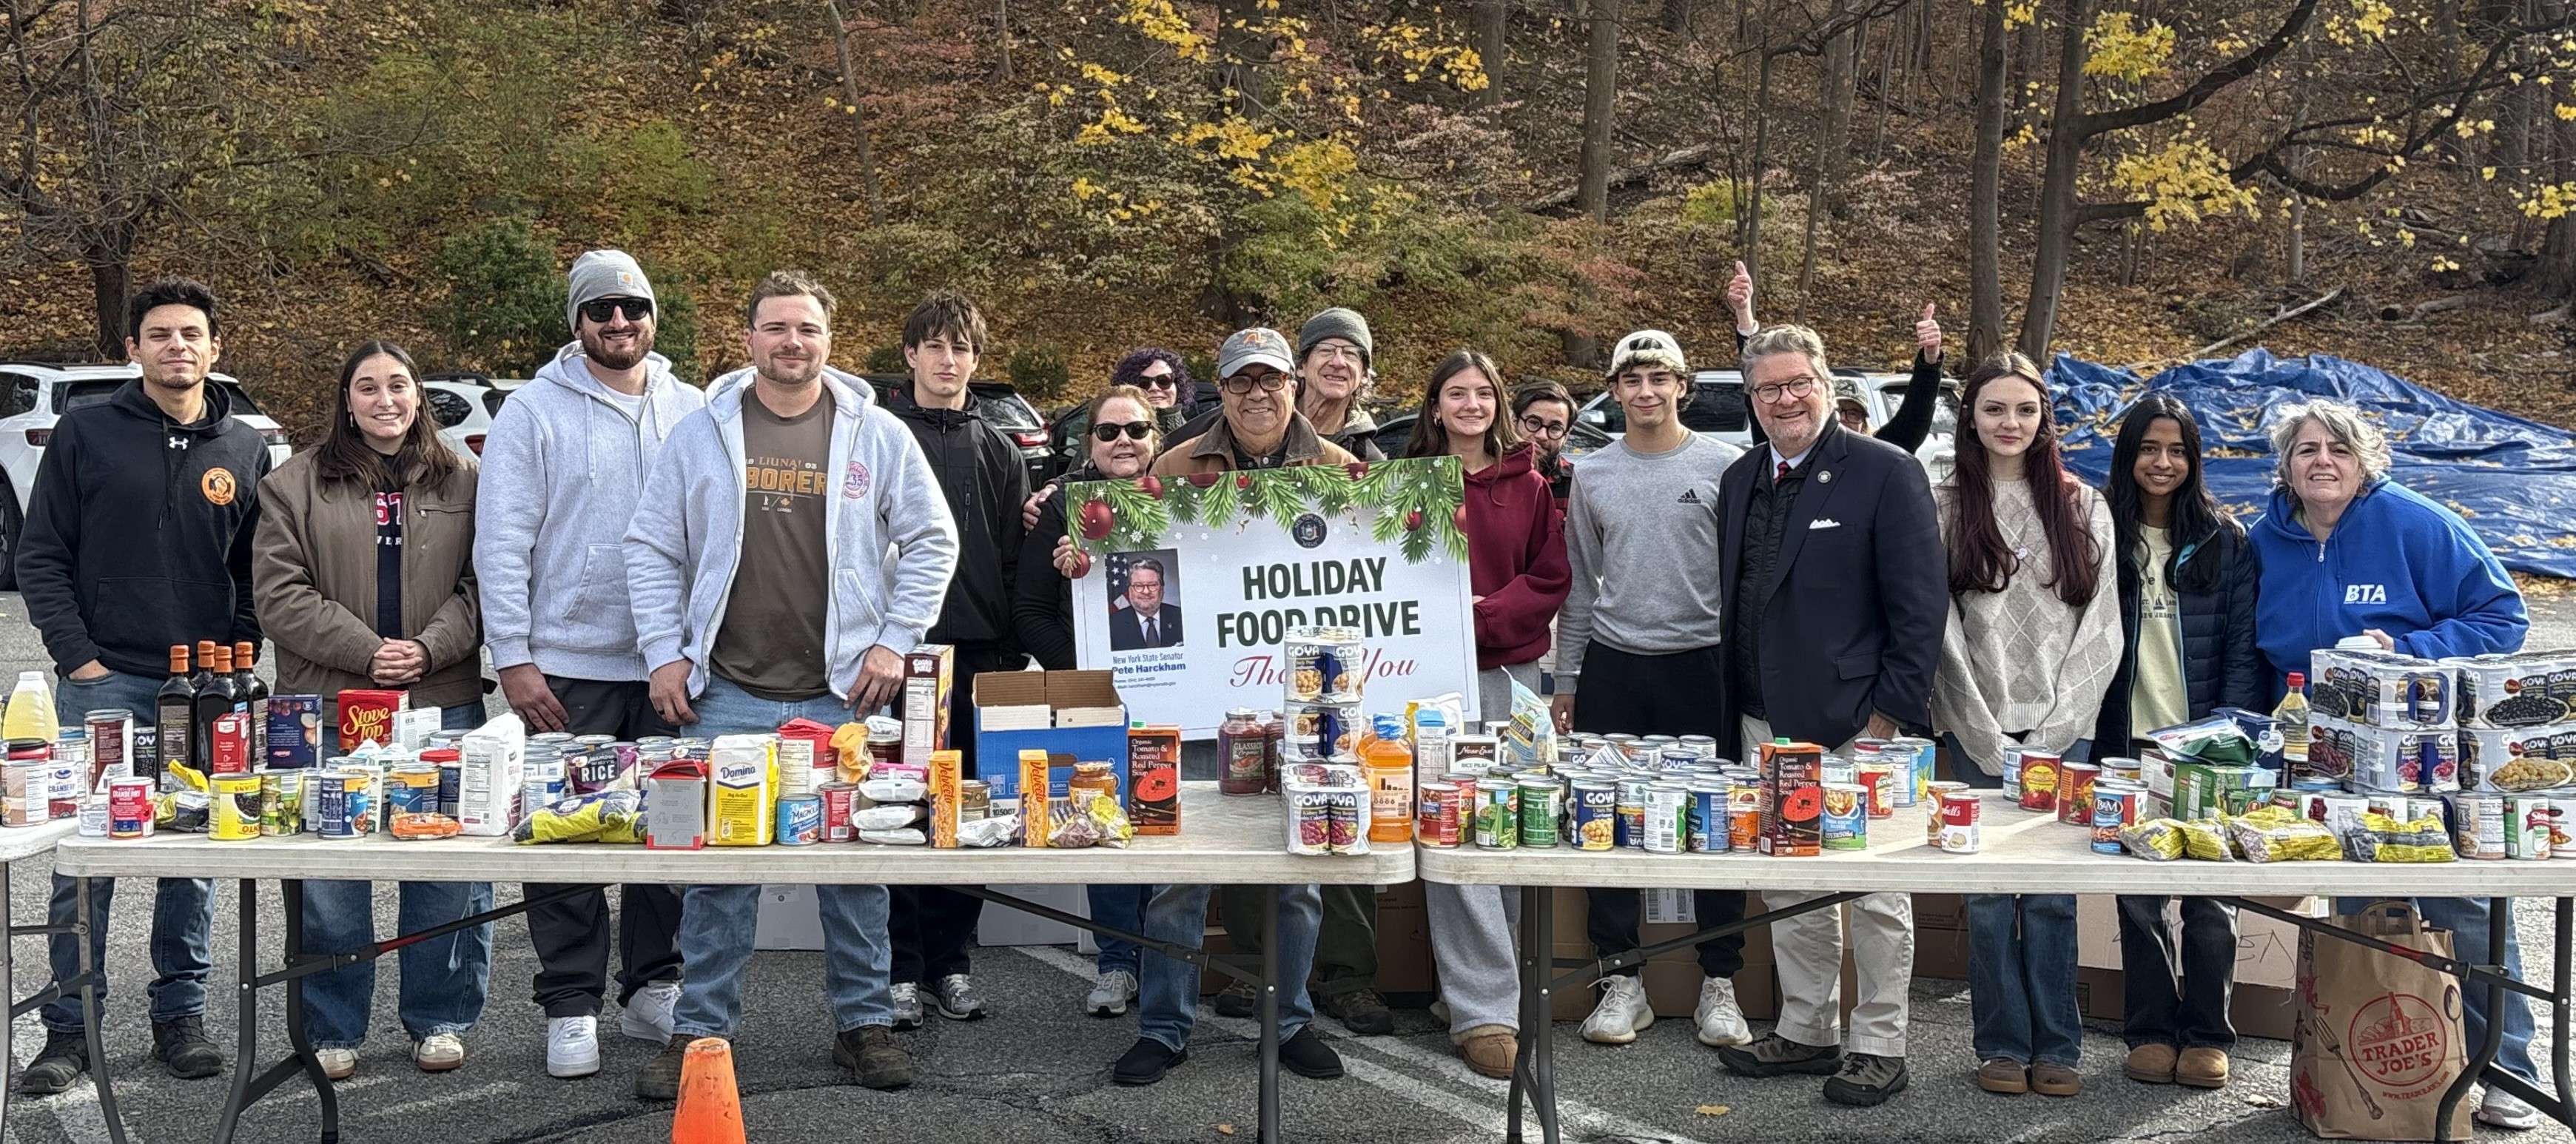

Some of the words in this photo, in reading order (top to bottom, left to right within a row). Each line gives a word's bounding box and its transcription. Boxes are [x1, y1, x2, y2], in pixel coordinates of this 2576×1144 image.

[759, 456, 801, 468] LIUNA!
[1242, 556, 1387, 600] HOLIDAY
[2344, 584, 2387, 602] BTA
[1288, 645, 1319, 657] GOYA
[1113, 656, 1126, 664] New
[1128, 655, 1141, 663] York
[1142, 653, 1159, 662] State
[1159, 652, 1183, 661] Senator
[1112, 666, 1134, 674] Pete
[1135, 662, 1186, 673] Harckham
[1362, 647, 1419, 685] You
[343, 704, 391, 736] Stove
[361, 722, 384, 743] Top
[1131, 752, 1160, 760] Roasted
[1457, 745, 1478, 756] Near
[1479, 744, 1494, 756] East
[720, 764, 756, 779] Domino
[1131, 760, 1146, 768] Red
[1148, 760, 1172, 770] Pepper
[1779, 762, 1804, 770] Tomato
[1805, 762, 1813, 770] &
[581, 764, 616, 782] RICE
[1131, 769, 1149, 778] Soup
[1779, 770, 1806, 778] Roasted
[938, 762, 955, 804] Velveeta
[1029, 761, 1044, 804] Velveeta
[1779, 779, 1792, 787] Red
[1793, 779, 1817, 789] Pepper
[1294, 793, 1328, 806] GOYA
[1779, 789, 1795, 797] Soup
[2096, 799, 2118, 812] B&M
[2362, 1032, 2440, 1062] TRADER
[2377, 1052, 2432, 1075] JOE'S
